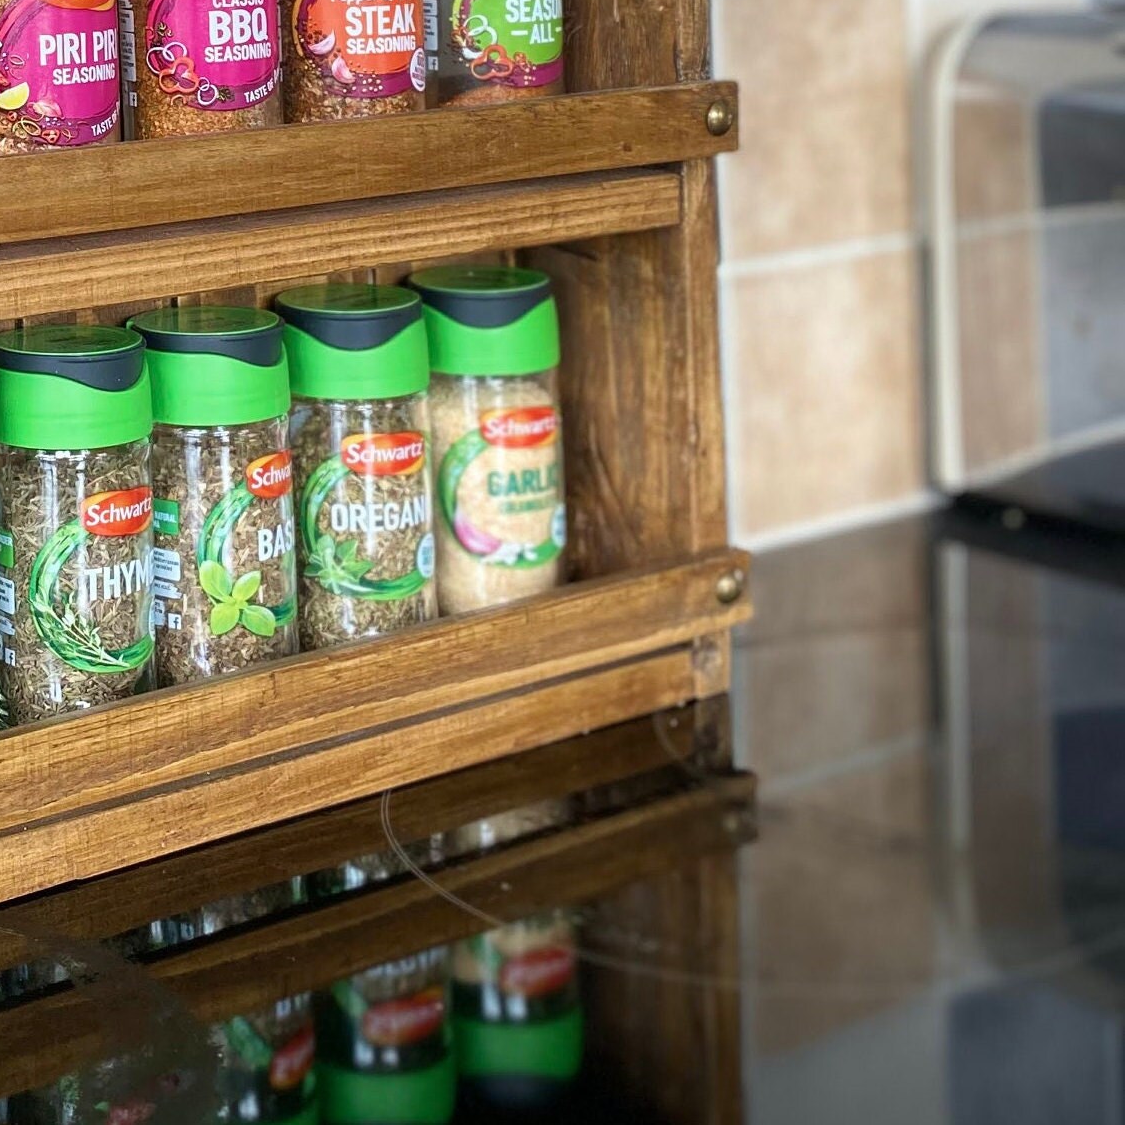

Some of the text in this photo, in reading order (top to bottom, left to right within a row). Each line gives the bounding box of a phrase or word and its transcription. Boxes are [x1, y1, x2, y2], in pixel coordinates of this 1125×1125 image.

[208, 7, 269, 45] BBQ
[345, 3, 416, 37] STEAK
[529, 23, 555, 45] ALL
[39, 32, 87, 66] PIRI
[204, 42, 271, 63] SEASONING
[346, 35, 416, 55] SEASONING
[52, 62, 115, 86] SEASONING
[244, 85, 268, 103] TASTE
[91, 116, 113, 137] TASTE
[346, 438, 423, 464] Schwartz
[251, 461, 292, 489] Schwa
[84, 494, 153, 526] Schwartz
[330, 494, 428, 532] OREGAN
[258, 516, 294, 562] BAS
[83, 552, 152, 601] THYM
